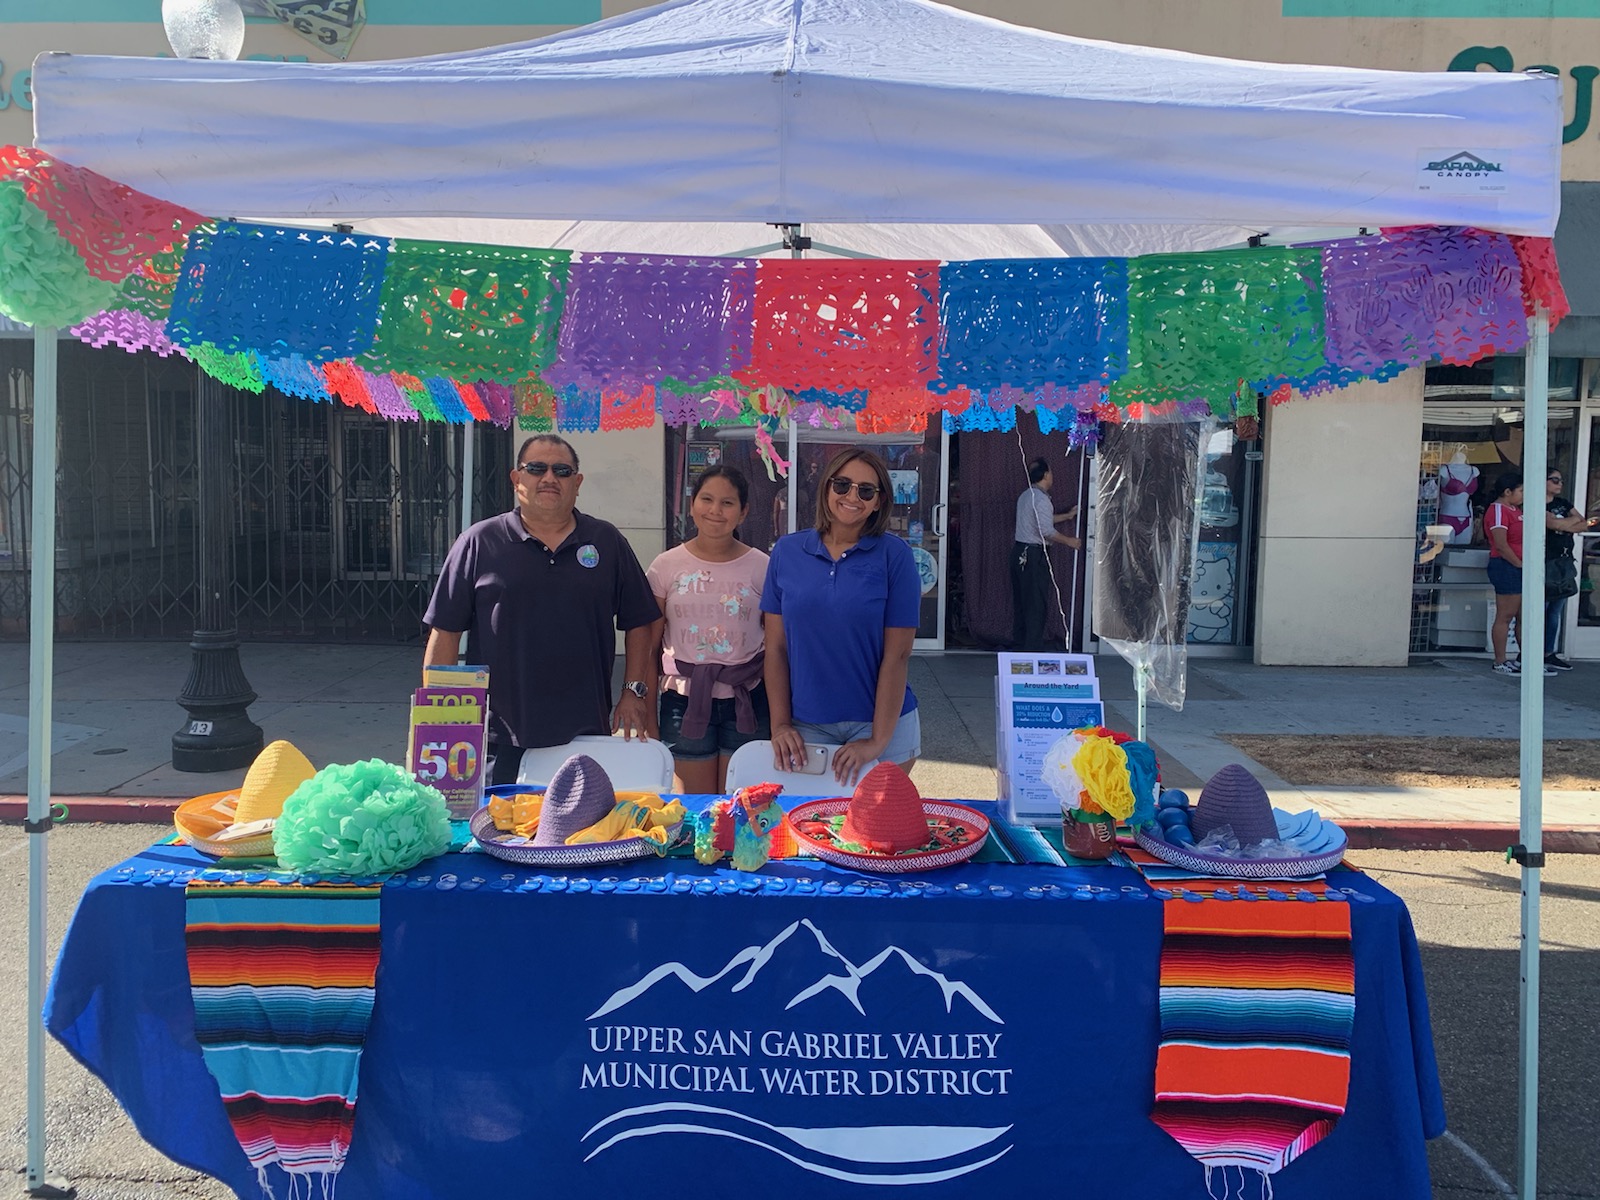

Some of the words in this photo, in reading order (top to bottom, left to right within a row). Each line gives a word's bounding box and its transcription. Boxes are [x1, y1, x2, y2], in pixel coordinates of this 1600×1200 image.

[190, 723, 208, 733] 43
[418, 741, 476, 782] 50
[589, 1026, 689, 1054] UPPER
[694, 1029, 752, 1056] SAN
[760, 1030, 888, 1060] GABRIEL
[892, 1032, 1003, 1060] VALLEY
[579, 1062, 755, 1093] MUNICIPAL
[759, 1067, 865, 1096] WATER
[869, 1068, 1013, 1096] DISTRICT
